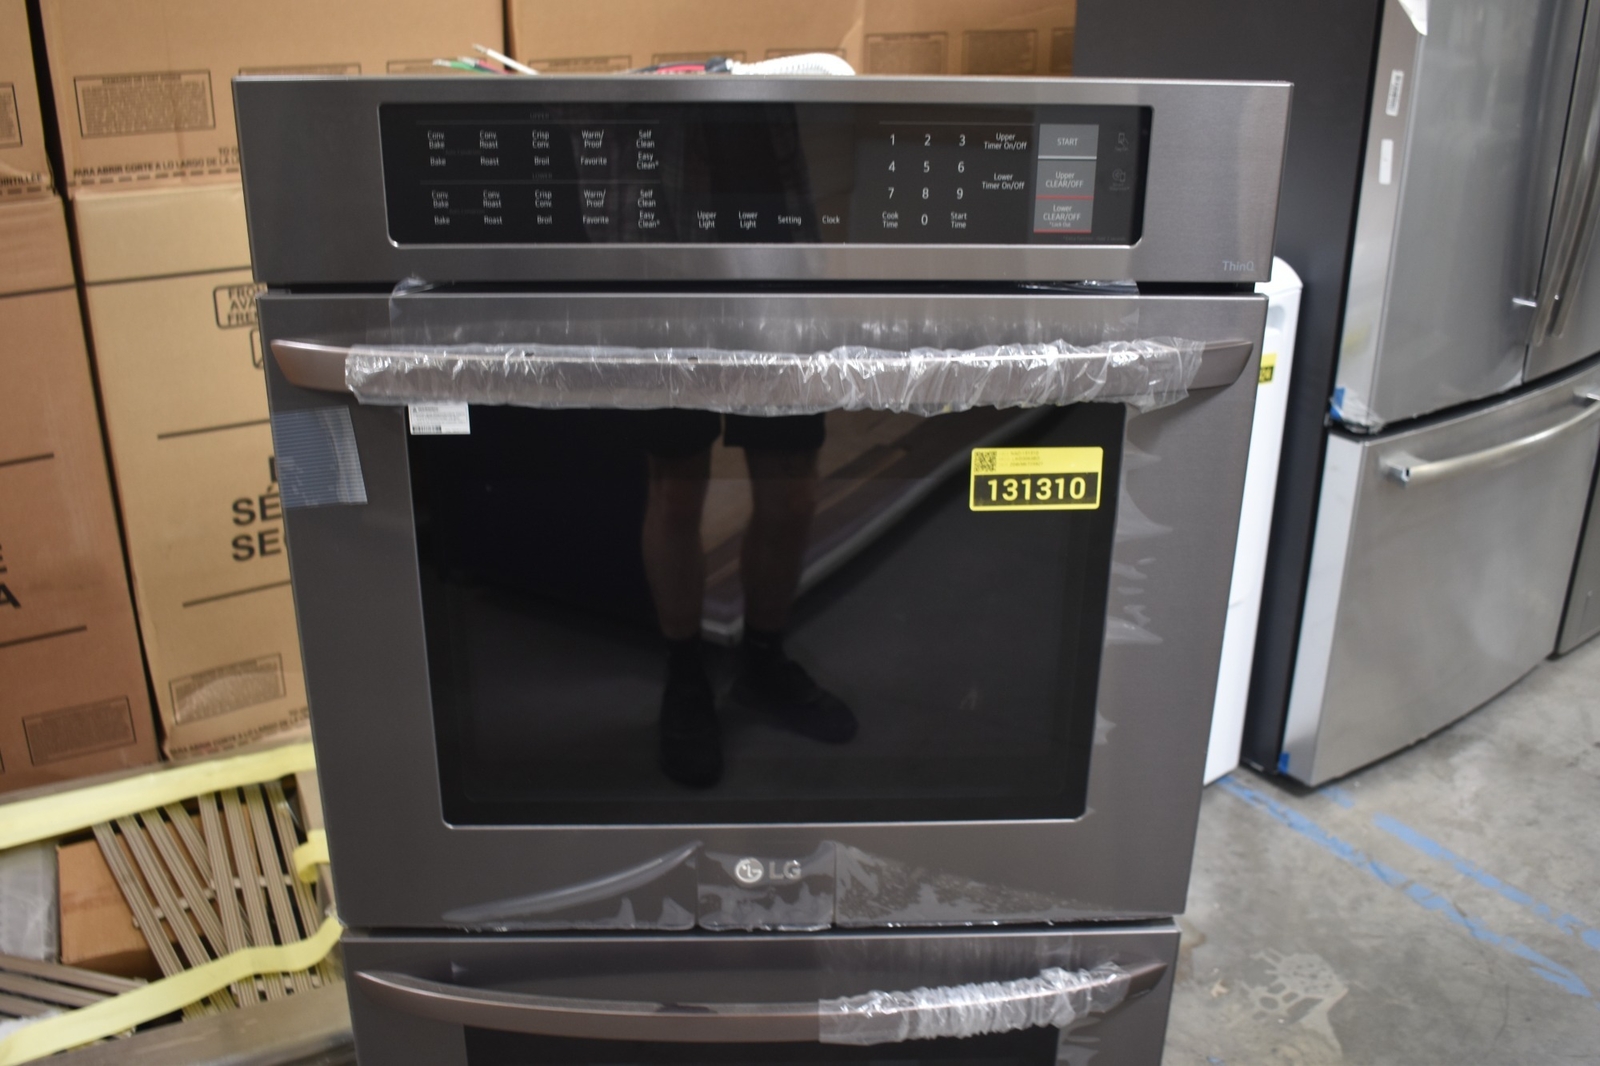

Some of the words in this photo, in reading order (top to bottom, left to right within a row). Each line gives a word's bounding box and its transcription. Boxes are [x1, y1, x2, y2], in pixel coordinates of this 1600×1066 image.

[532, 130, 550, 141] Crisp
[638, 130, 652, 140] Self
[890, 134, 895, 146] 1
[924, 134, 931, 146] 2
[959, 134, 966, 146] 3
[996, 132, 1016, 141] Upper
[429, 140, 445, 150] Bake
[480, 140, 498, 149] Roast
[584, 140, 602, 149] Proof
[636, 139, 655, 149] Clean
[984, 142, 1002, 150] Timer
[1004, 141, 1027, 151] On/Off
[1057, 138, 1078, 146] START
[430, 157, 446, 166] Bake
[481, 157, 500, 166] Roast
[534, 156, 550, 166] Broil
[580, 156, 607, 166] Favorite
[638, 152, 653, 162] Easy
[74, 166, 95, 177] PARA
[97, 164, 123, 176] ABRIR
[125, 162, 153, 173] CORTE
[888, 161, 895, 172] 4
[923, 161, 930, 172] 5
[958, 161, 964, 173] 6
[994, 173, 1013, 181] Lower
[1055, 171, 1075, 180] Upper
[1002, 182, 1025, 190] On/Off
[1046, 180, 1084, 189] CLEAR/OFF
[535, 190, 552, 200] Crisp
[640, 189, 653, 199] Self
[888, 187, 895, 198] 7
[922, 188, 929, 199] 8
[956, 188, 963, 200] 9
[433, 199, 449, 209] Bake
[483, 199, 502, 209] Roast
[586, 199, 605, 208] Proof
[637, 198, 656, 208] Clean
[537, 215, 553, 225] Broil
[582, 215, 609, 225] Favorite
[639, 210, 655, 220] Easy
[697, 210, 717, 221] Upper
[739, 210, 758, 220] Lower
[822, 215, 840, 225] Clock
[882, 211, 899, 220] Cook
[951, 212, 967, 221] Start
[1043, 213, 1081, 222] CLEAR/OFF
[434, 216, 450, 225] Bake
[484, 216, 503, 225] Roast
[699, 219, 715, 230] Light
[740, 219, 757, 230] Light
[778, 215, 802, 226] Setting
[882, 220, 898, 229] Time
[951, 220, 967, 229] Time
[1222, 261, 1255, 272] ThinQ
[988, 477, 1086, 501] 131310
[769, 860, 801, 880] LG
